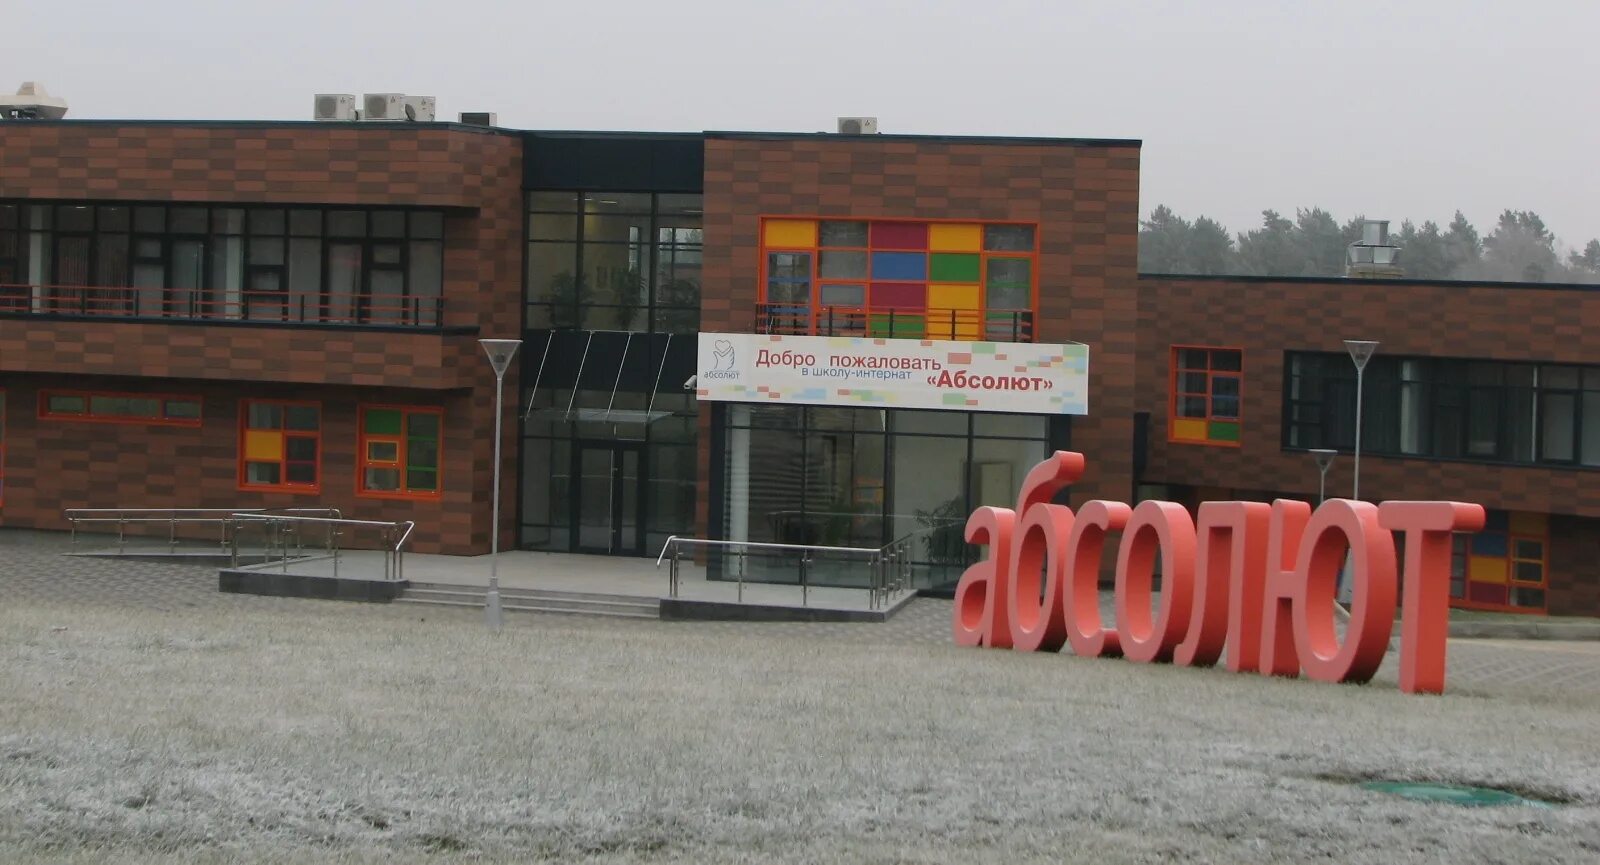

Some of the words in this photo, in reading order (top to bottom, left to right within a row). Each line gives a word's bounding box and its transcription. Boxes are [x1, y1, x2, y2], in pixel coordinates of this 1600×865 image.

[756, 349, 816, 369] Добро
[830, 355, 942, 370] пожаловать
[703, 371, 741, 380] абсолют
[802, 368, 809, 376] в
[813, 368, 912, 380] школу-интернат
[927, 370, 1053, 391] «Абсолют»
[952, 450, 1485, 694] абсолют
